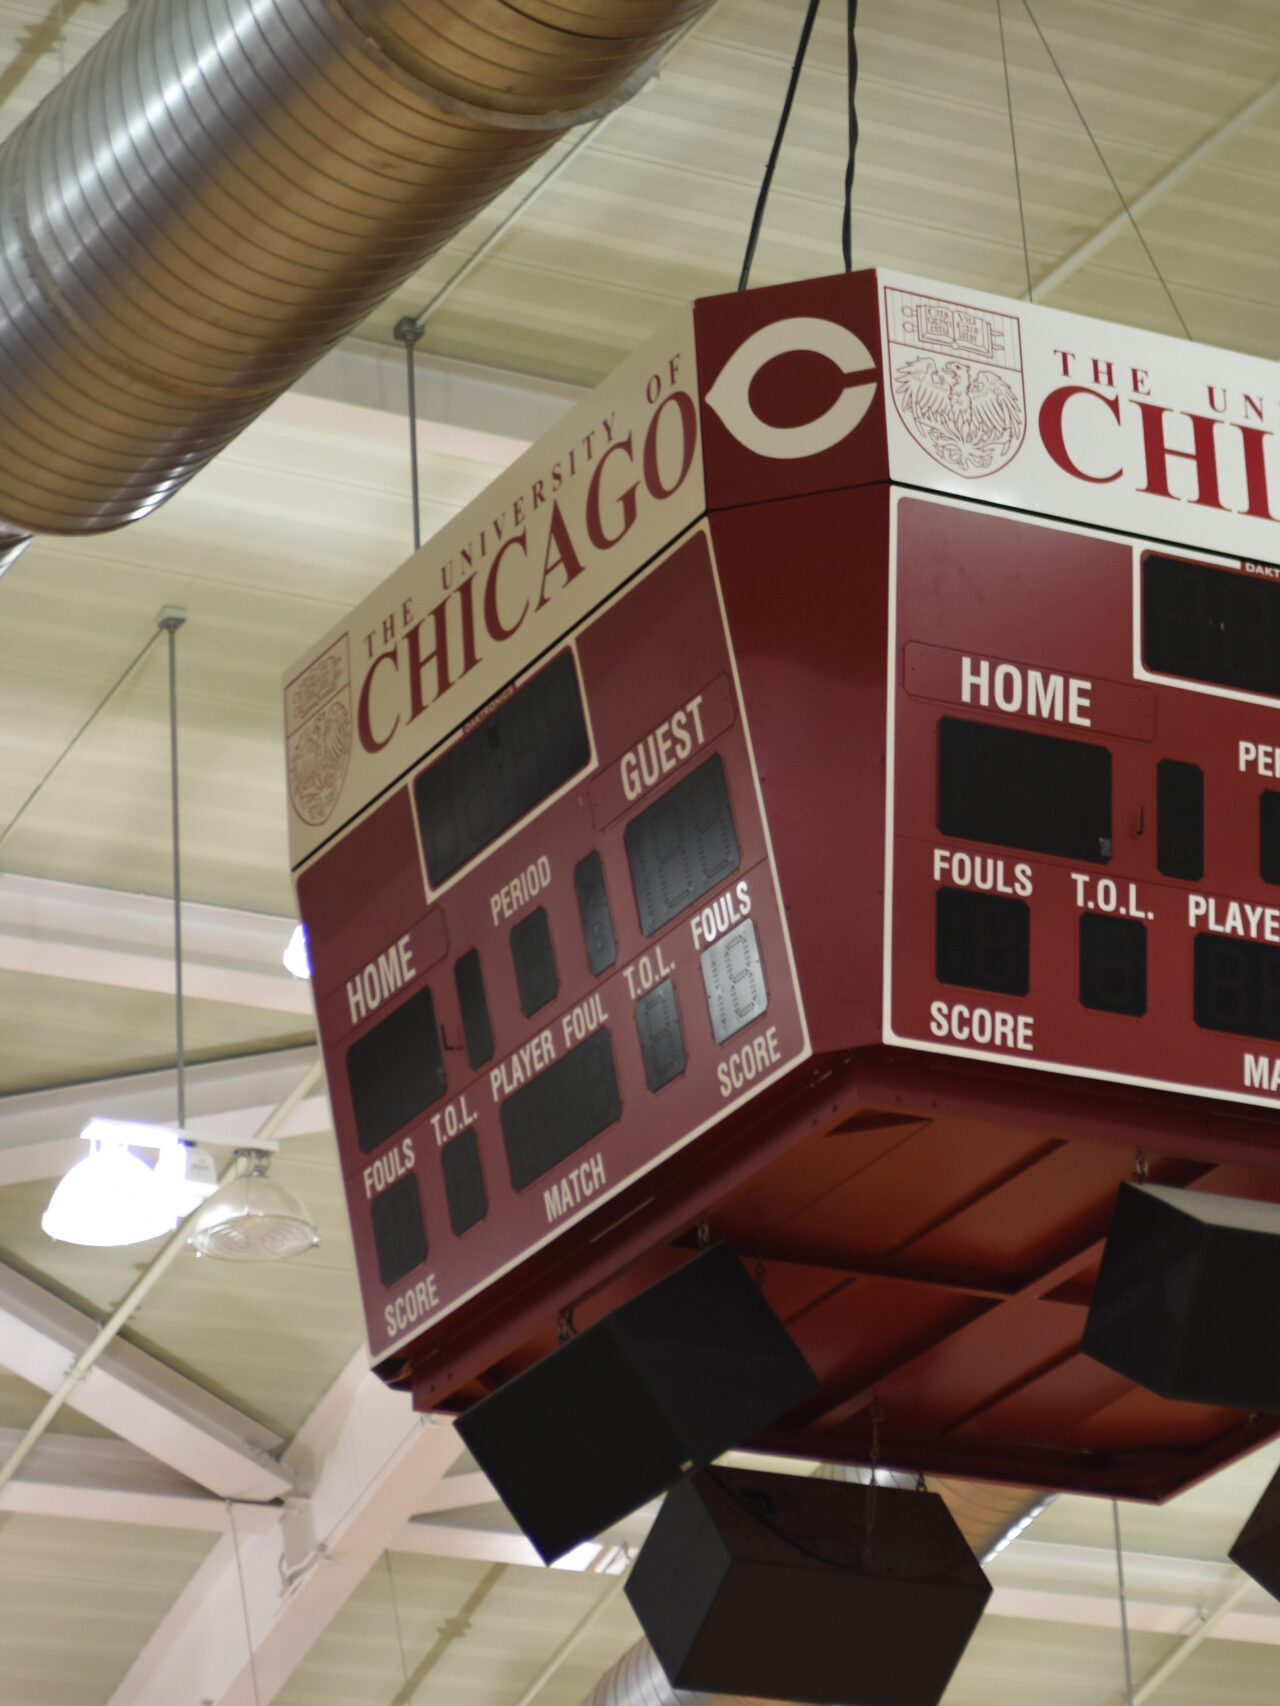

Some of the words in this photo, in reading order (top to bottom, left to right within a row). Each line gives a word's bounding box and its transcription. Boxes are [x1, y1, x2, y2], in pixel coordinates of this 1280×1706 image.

[1053, 349, 1151, 396] THE
[363, 597, 413, 660] THE
[440, 412, 616, 591] UNIVERSITY
[645, 354, 682, 405] OF
[357, 390, 698, 754] CHICAGO
[961, 656, 1092, 727] HOME
[620, 696, 706, 801] GUEST
[489, 855, 552, 926] PERIOD
[933, 848, 1034, 896] FOULS
[1071, 873, 1154, 920] T.O.L.
[690, 881, 752, 951] FOULS
[346, 936, 417, 1024] HOME
[623, 945, 676, 1000] T.O.L.
[489, 1029, 556, 1102] PLAYER
[562, 992, 609, 1044] FOUL
[930, 1001, 1034, 1051] SCORE
[716, 1026, 781, 1098] SCORE
[430, 1093, 478, 1147] T.O.L.
[363, 1138, 415, 1199] FOULS
[543, 1152, 607, 1223] MATCH
[384, 1274, 439, 1338] SCORE
